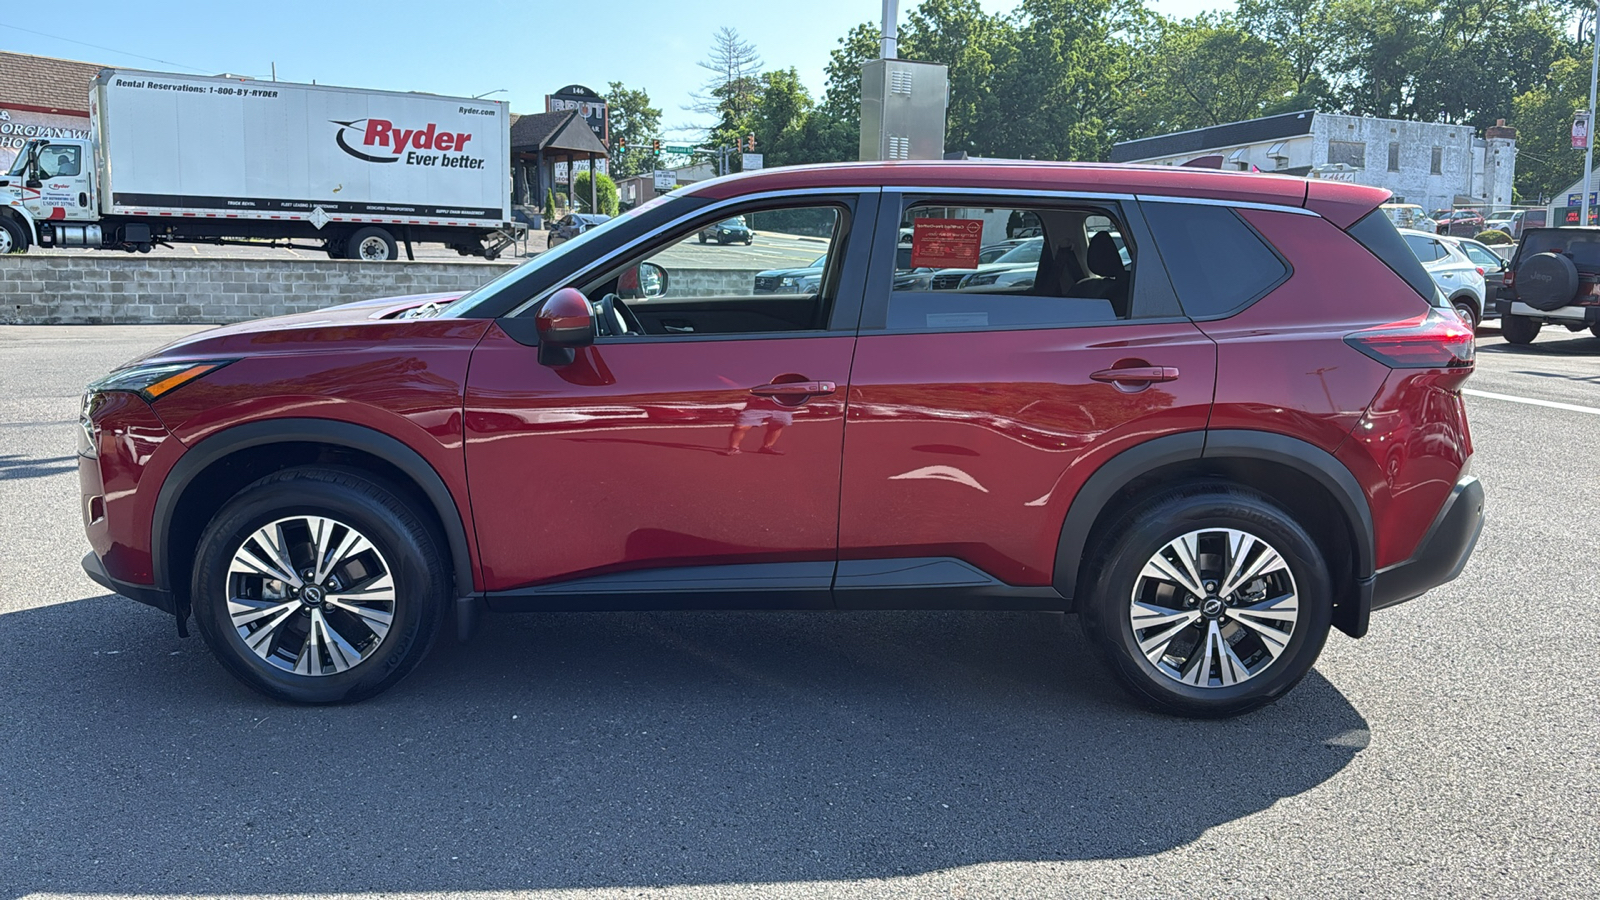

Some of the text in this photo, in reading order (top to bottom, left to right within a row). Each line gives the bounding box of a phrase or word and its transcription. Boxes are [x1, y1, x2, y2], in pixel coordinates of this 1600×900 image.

[115, 78, 279, 98] Rental Reservations: 1-800-BY-RYDER
[458, 106, 496, 116] Ryder.com
[0, 122, 92, 141] ORGIAN WI
[363, 119, 472, 154] Ryder
[0, 136, 25, 149] HO
[406, 151, 485, 170] Ever better.
[1529, 270, 1553, 283] Jeep
